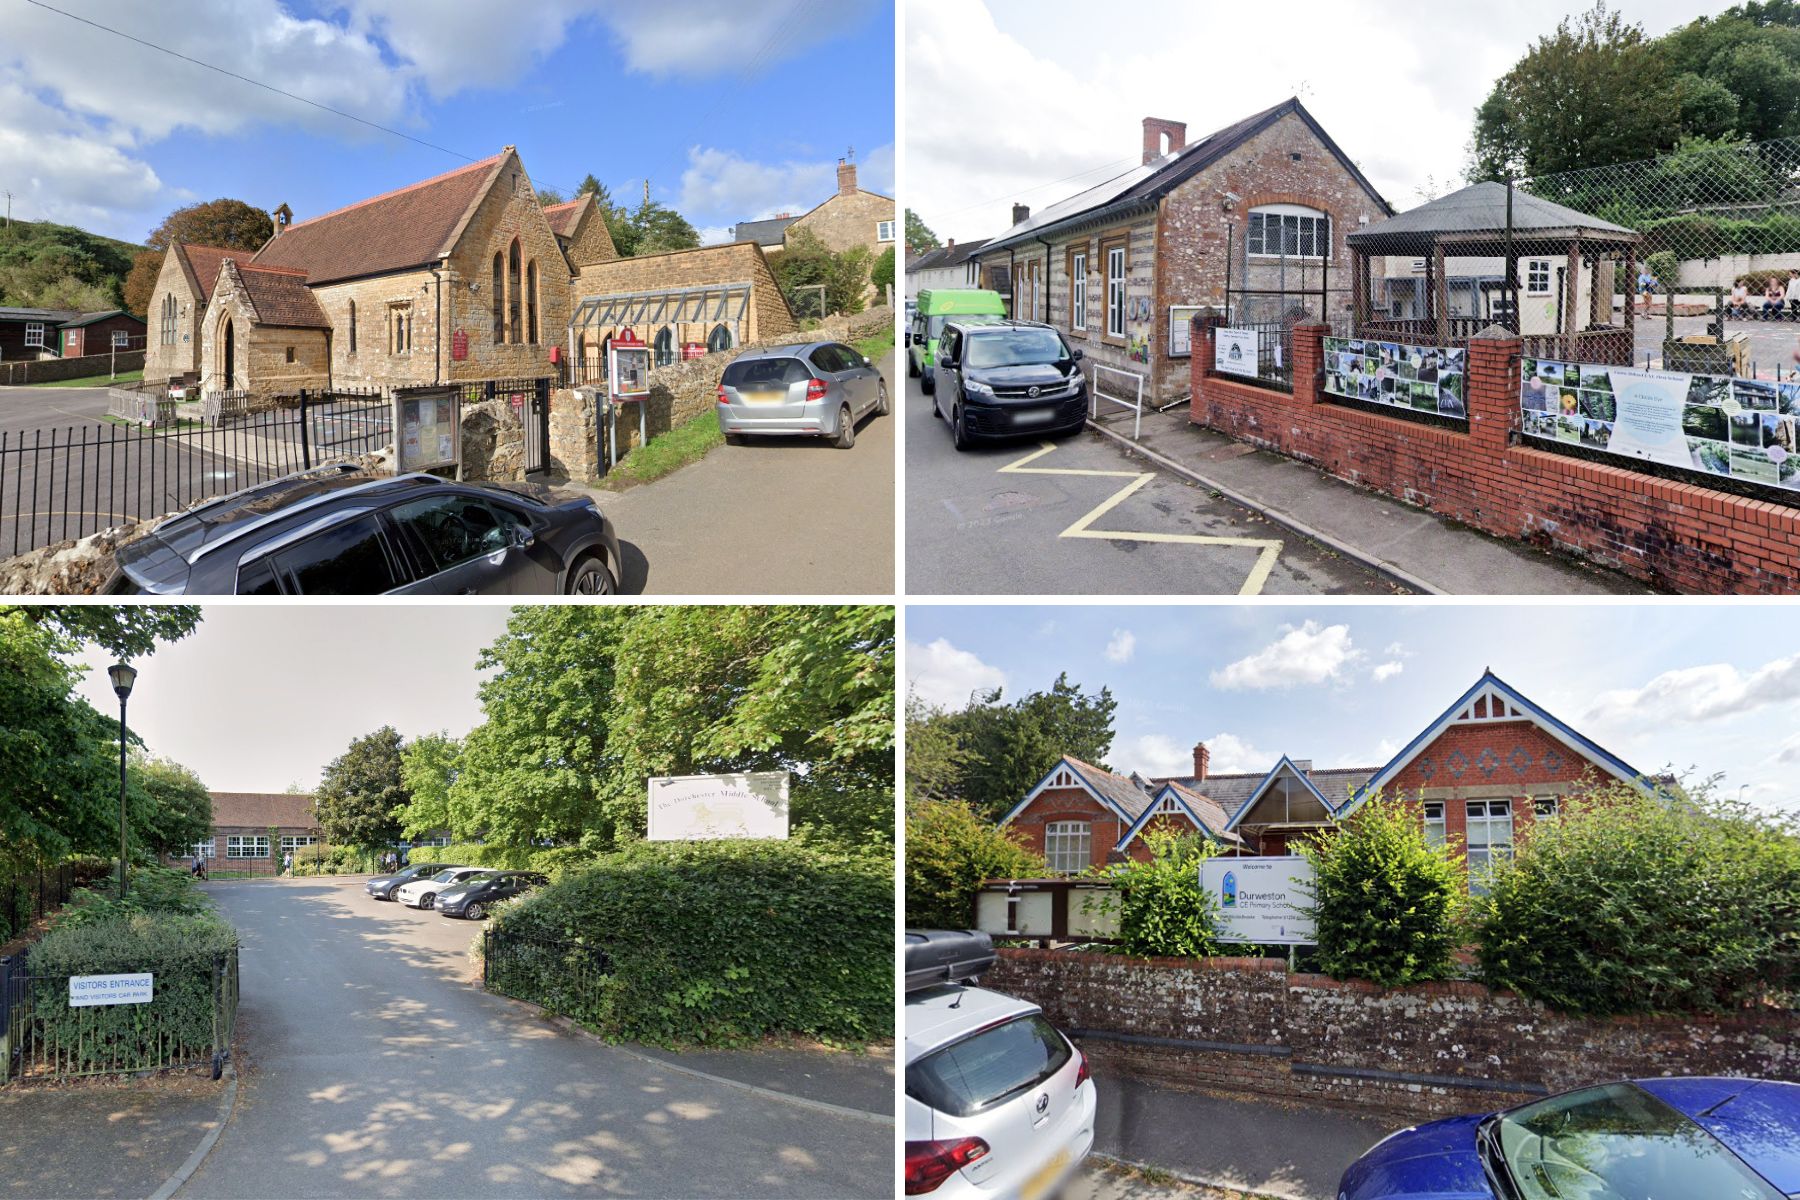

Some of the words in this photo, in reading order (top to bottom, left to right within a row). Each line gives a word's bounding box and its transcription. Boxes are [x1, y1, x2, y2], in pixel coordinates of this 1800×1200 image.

[674, 791, 716, 803] Dorchester
[720, 790, 748, 799] Middle
[752, 794, 779, 808] School
[1239, 891, 1286, 900] Durweston
[1249, 901, 1271, 910] Primary
[73, 980, 107, 990] VISITORS
[110, 979, 150, 989] ENTRANCE
[90, 992, 117, 1000] VISITORS
